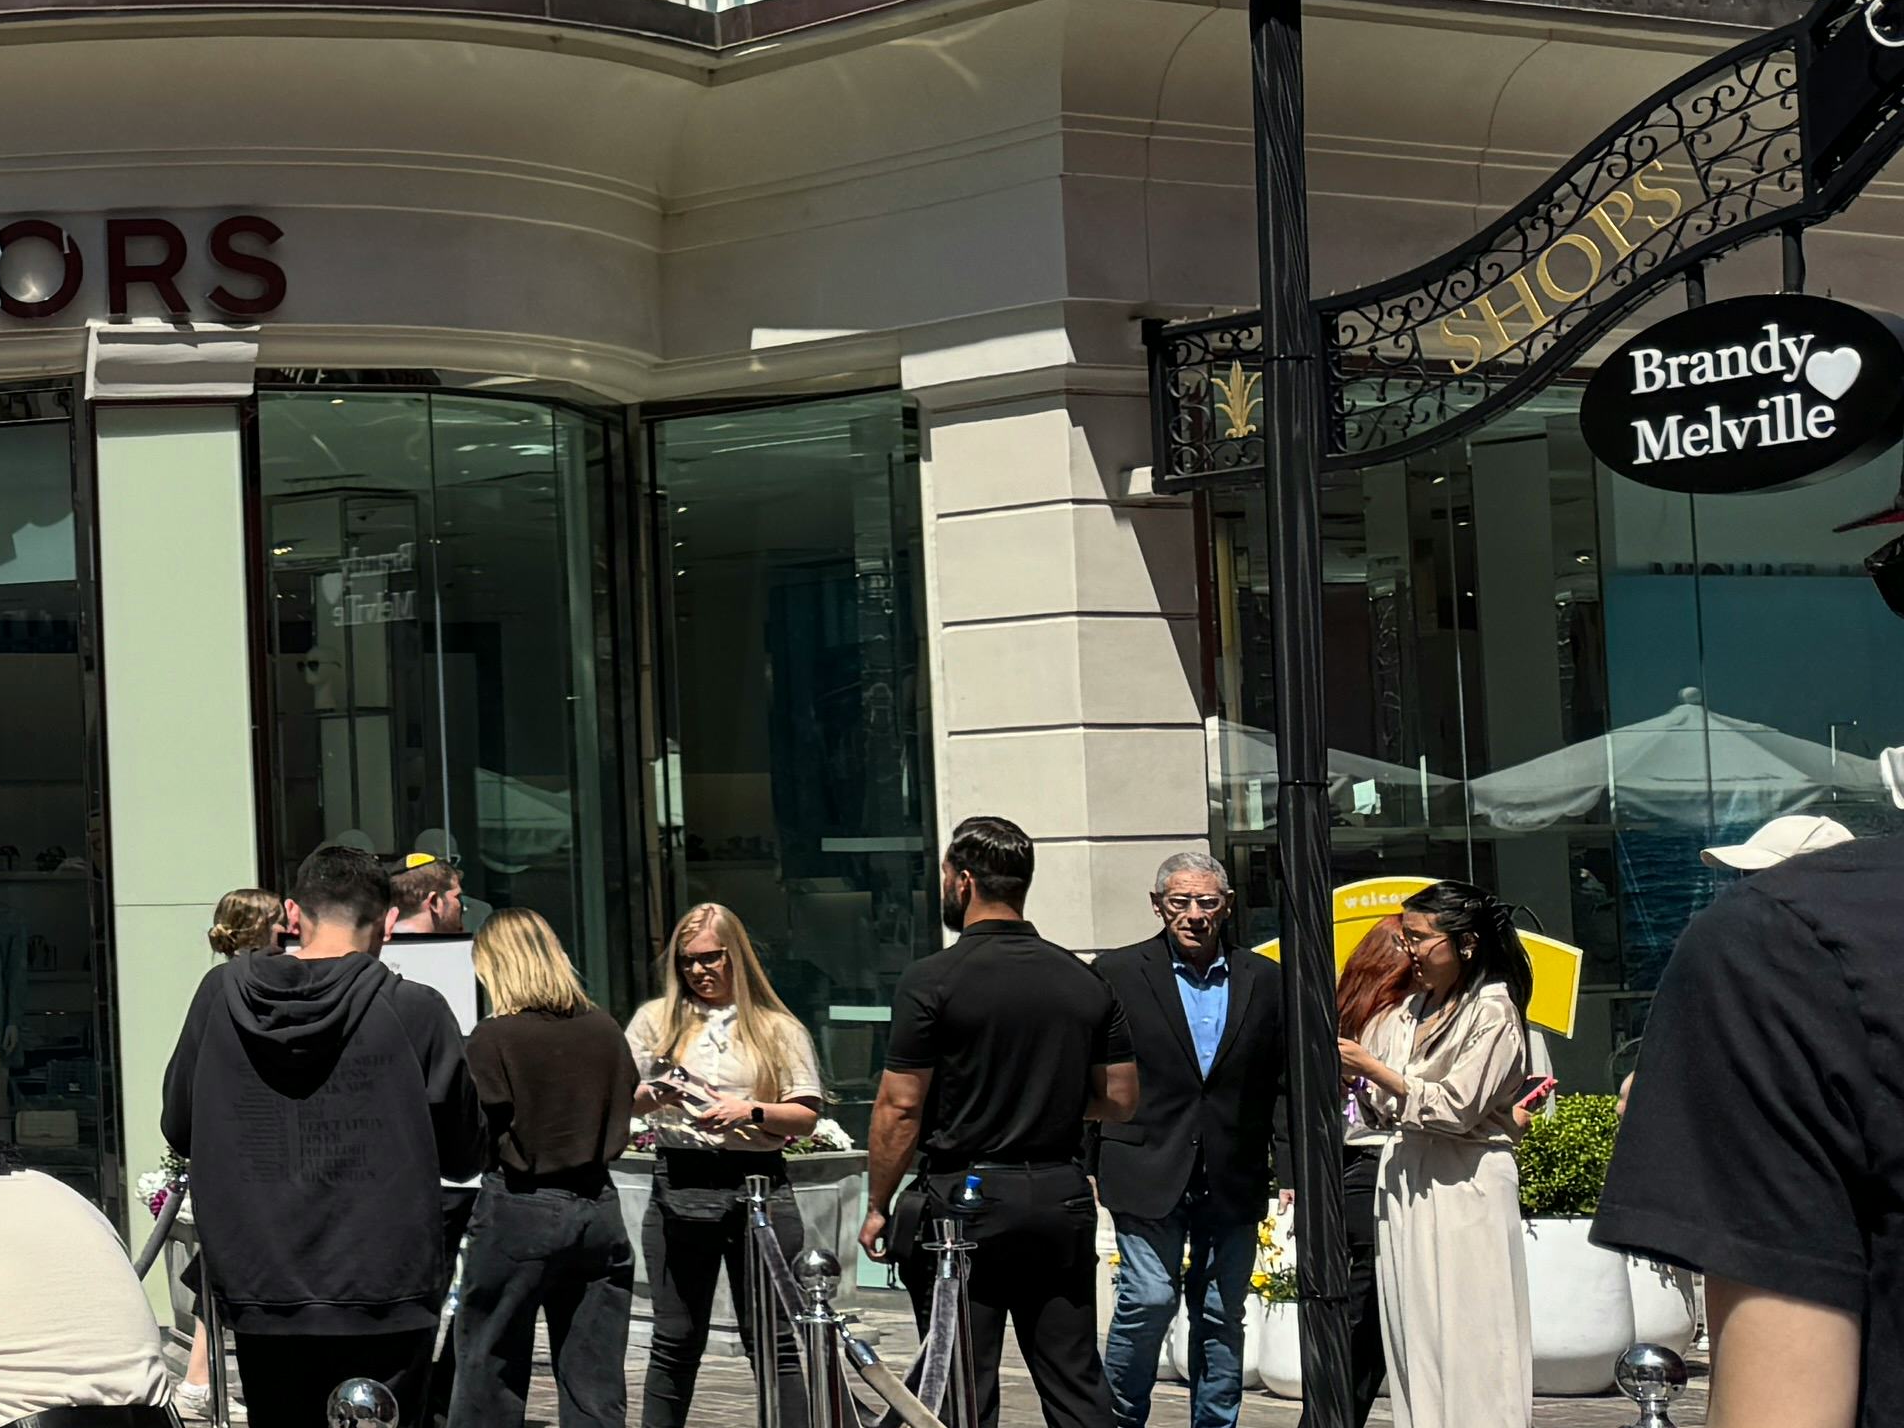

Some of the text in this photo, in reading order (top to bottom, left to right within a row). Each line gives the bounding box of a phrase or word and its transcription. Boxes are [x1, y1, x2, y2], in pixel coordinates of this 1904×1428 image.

[1439, 160, 1684, 375] SHOPS
[1629, 324, 1815, 396] Brandy
[1631, 393, 1837, 465] Melville
